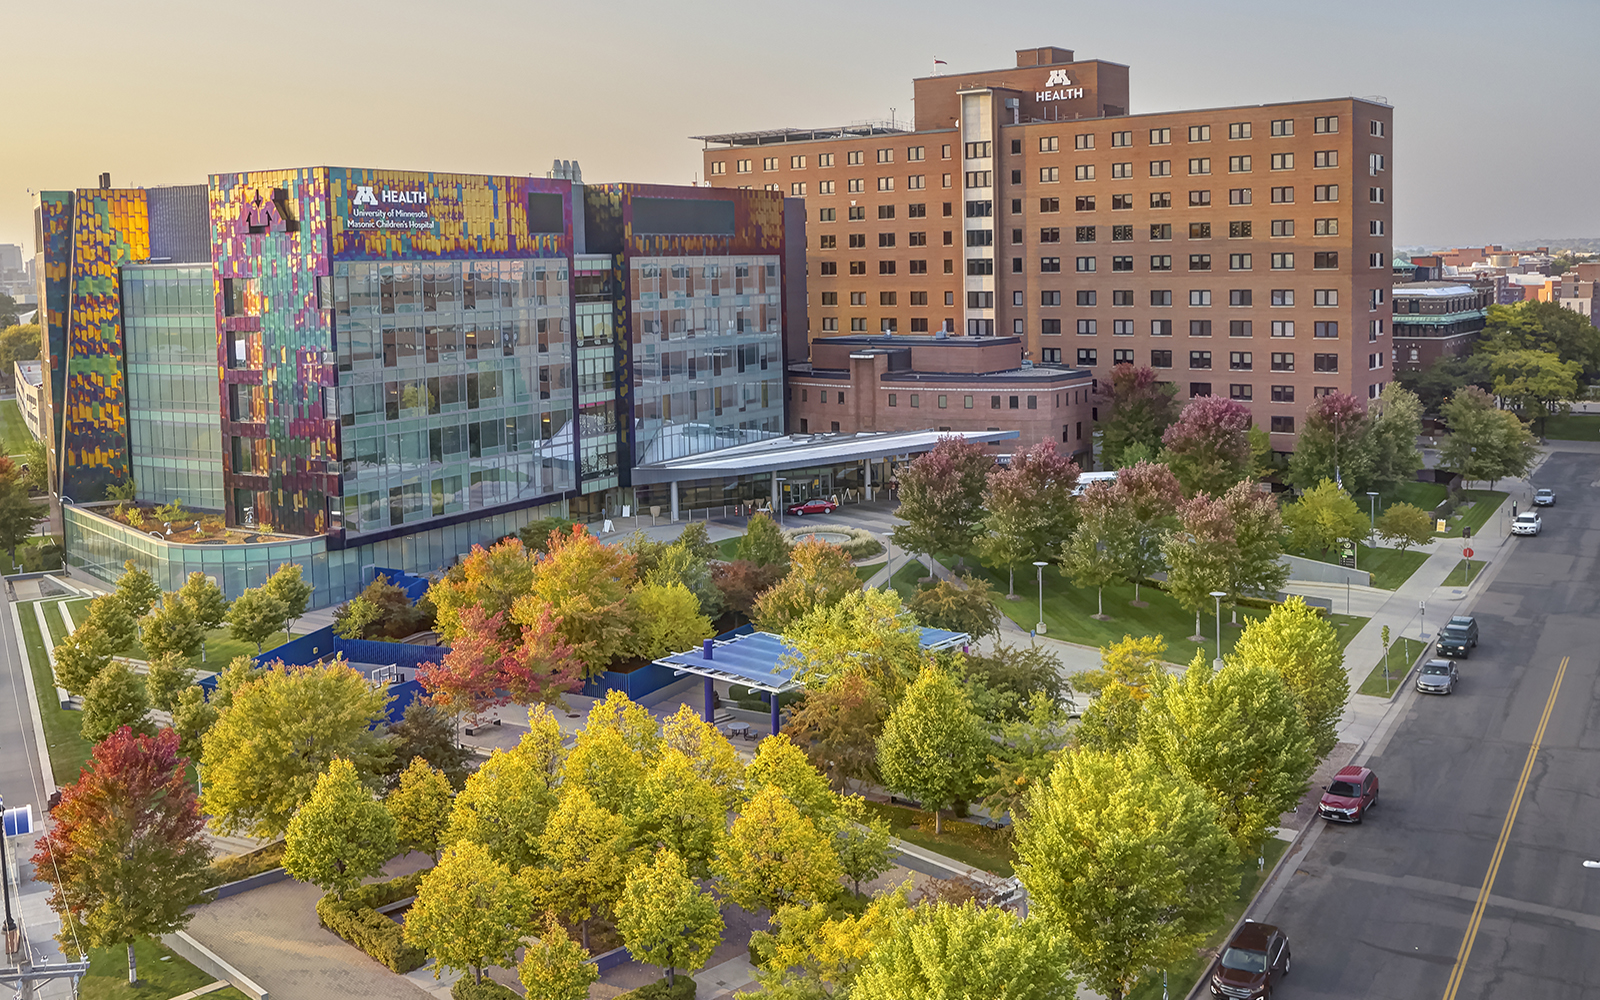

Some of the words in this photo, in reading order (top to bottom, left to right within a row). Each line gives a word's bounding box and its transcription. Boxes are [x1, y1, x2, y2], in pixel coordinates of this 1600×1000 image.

[1035, 87, 1083, 102] HEALTH
[381, 190, 428, 204] HEALTH
[353, 208, 386, 218] University
[387, 209, 395, 217] of
[395, 209, 428, 218] Minnesota
[347, 219, 375, 228] Masonic
[375, 219, 408, 229] Children's
[408, 220, 435, 230] Hospital
